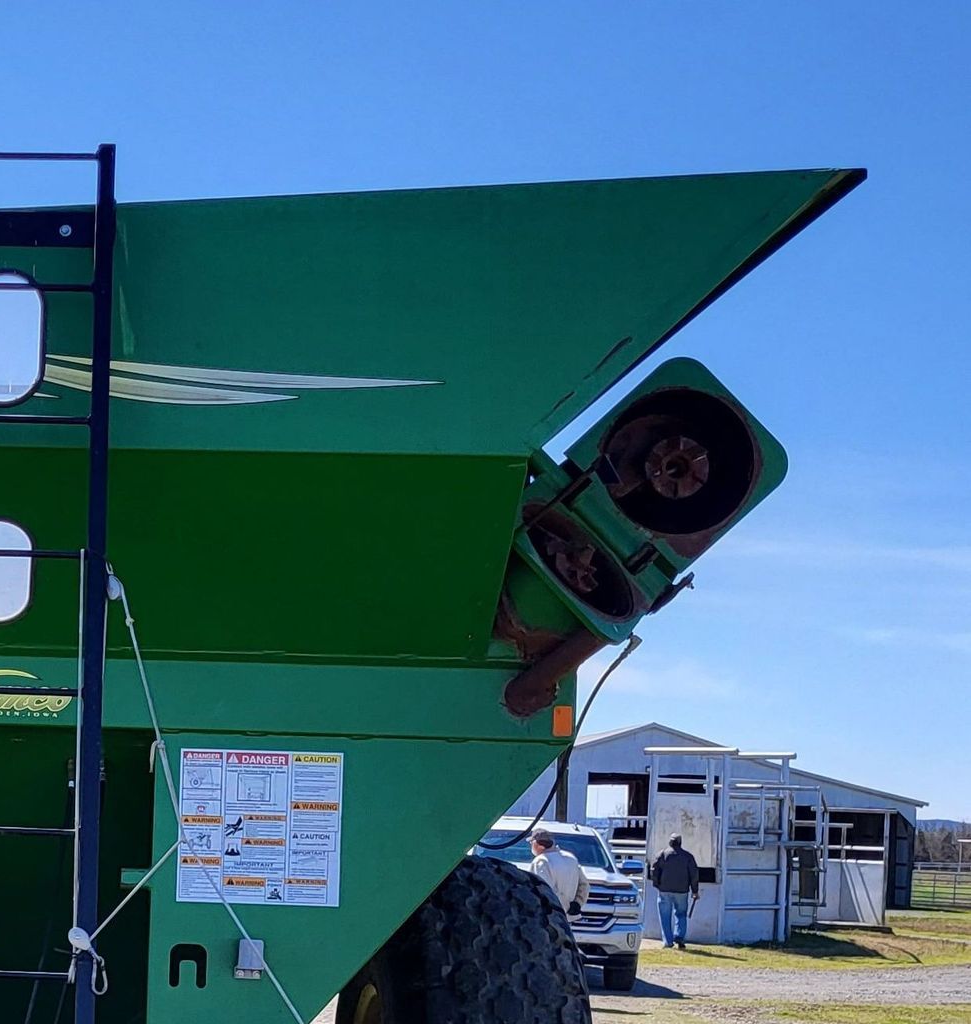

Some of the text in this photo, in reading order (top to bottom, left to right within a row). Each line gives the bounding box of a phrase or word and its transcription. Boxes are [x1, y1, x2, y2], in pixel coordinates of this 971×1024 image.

[241, 755, 286, 765] DANGER
[302, 803, 337, 811] WARNING
[188, 857, 220, 865] WANING
[234, 879, 265, 887] WARNING
